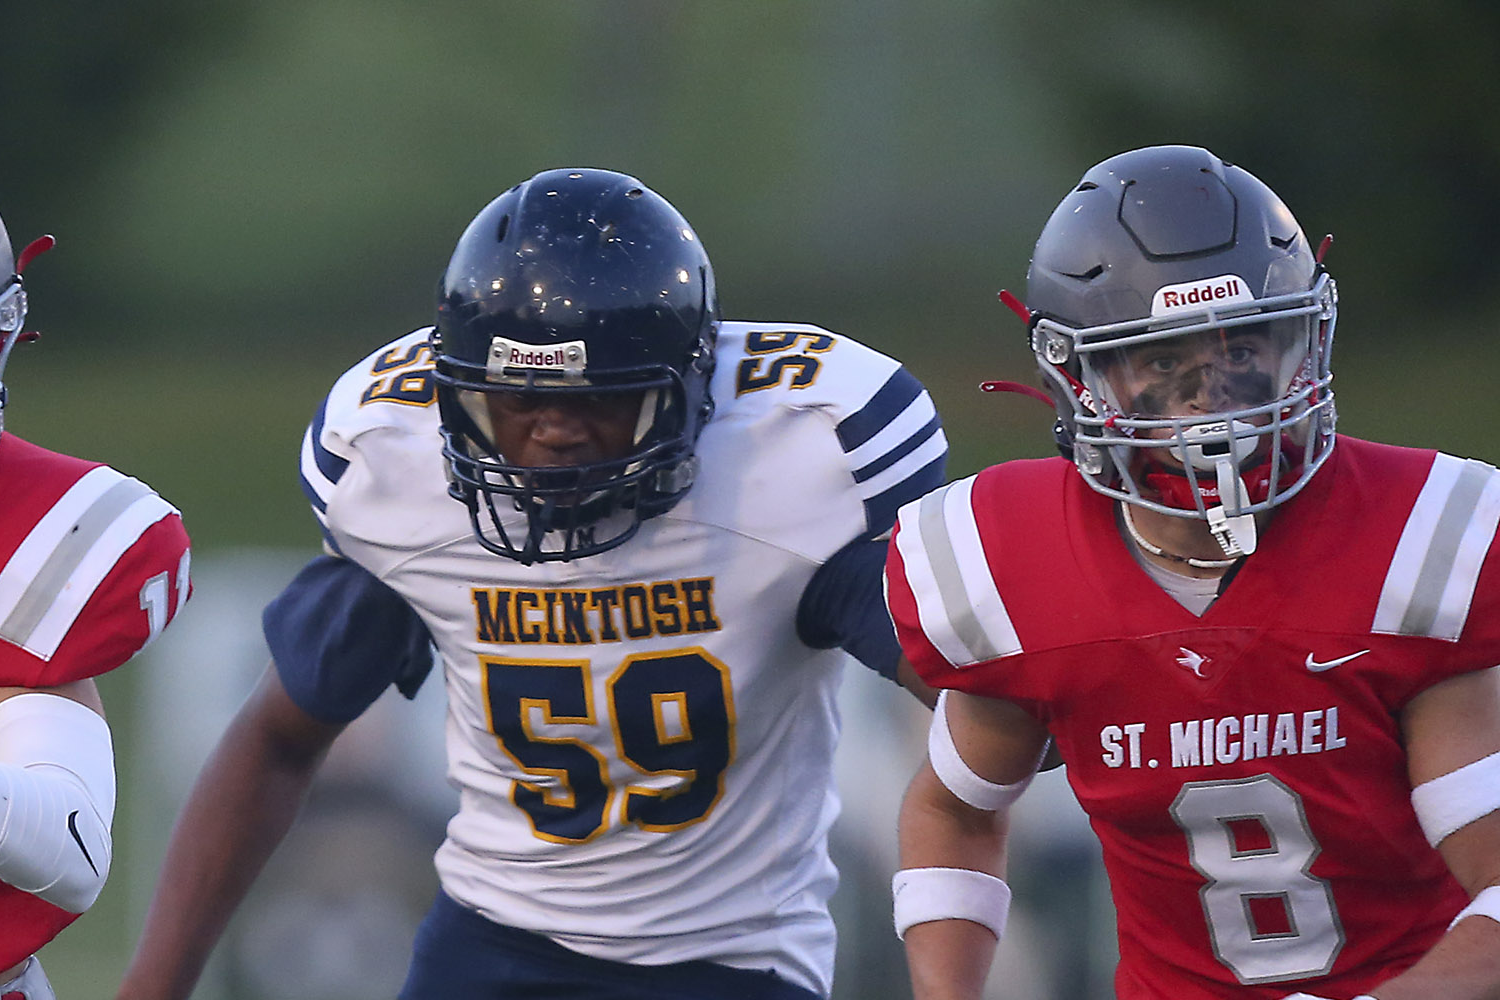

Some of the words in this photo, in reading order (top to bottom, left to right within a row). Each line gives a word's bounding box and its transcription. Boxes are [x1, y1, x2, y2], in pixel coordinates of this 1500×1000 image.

[1162, 279, 1240, 309] Riddell
[508, 347, 565, 367] Riddell
[471, 576, 722, 646] MCINTOSH
[478, 645, 737, 845] 59
[1100, 722, 1159, 769] ST.
[1169, 706, 1347, 768] MICHAEL
[1168, 772, 1347, 986] 8
